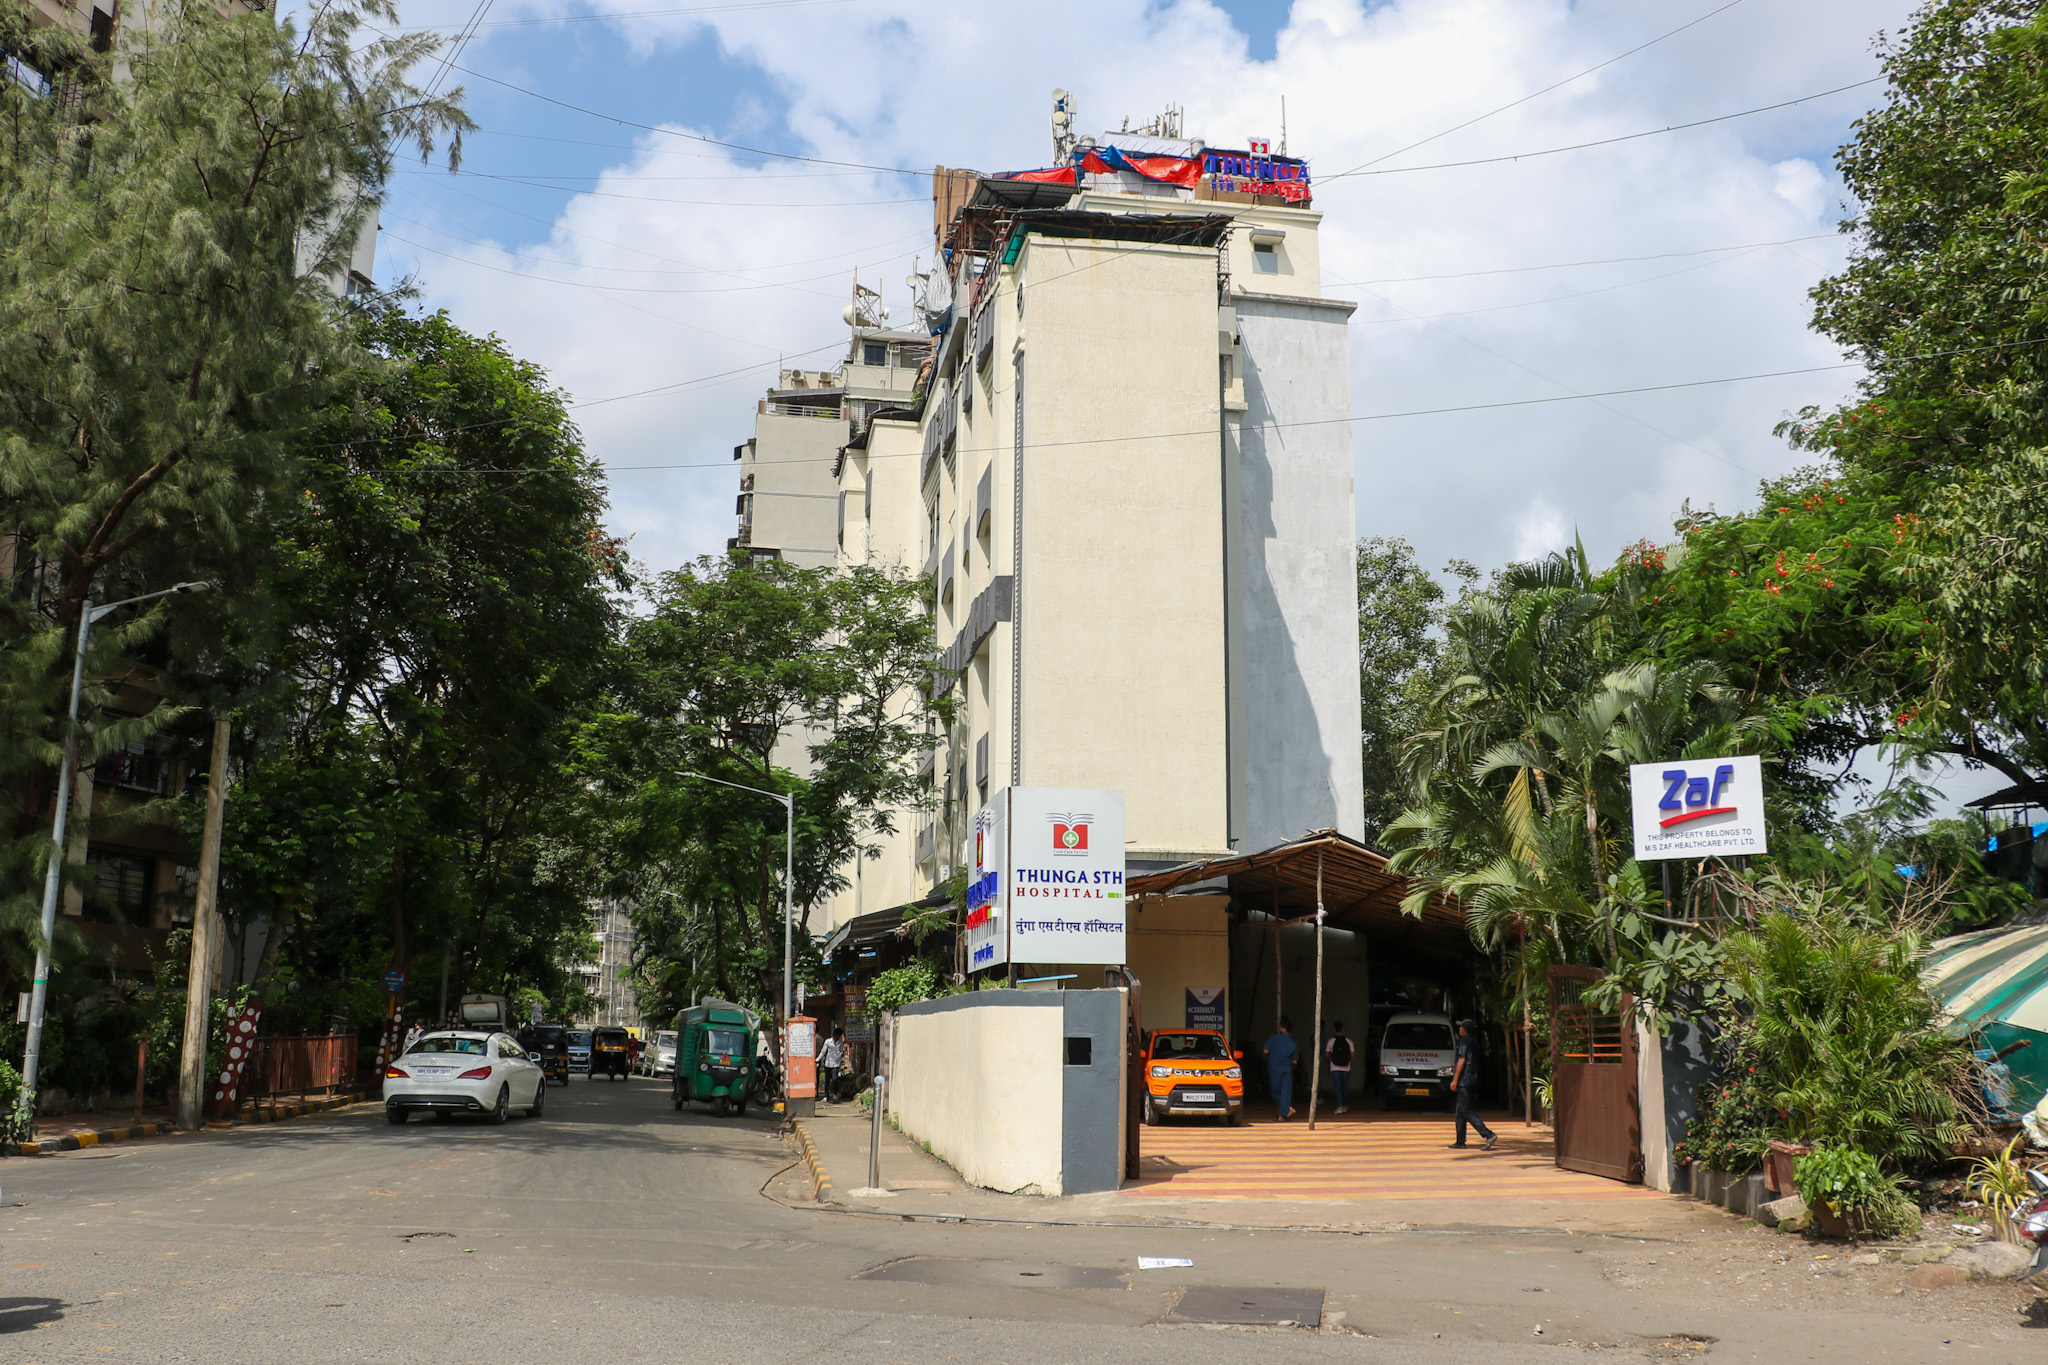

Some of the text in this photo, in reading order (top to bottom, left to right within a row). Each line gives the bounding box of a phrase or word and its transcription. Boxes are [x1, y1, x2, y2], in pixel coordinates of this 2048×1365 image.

[1206, 153, 1312, 184] THUNGA
[1241, 182, 1312, 199] HOSPITAL
[1658, 764, 1734, 810] Zaf
[1647, 828, 1752, 842] THIS PROPERTY BELONGS TO
[1659, 843, 1673, 851] ZAF
[1674, 839, 1722, 849] HEALTHCARE
[1723, 838, 1739, 846] PVT.
[1016, 869, 1123, 884] THUNGA STH
[1016, 887, 1104, 898] HOSPITAL
[1015, 917, 1036, 935] तुंगा
[1083, 918, 1124, 934] हॉस्पिटल
